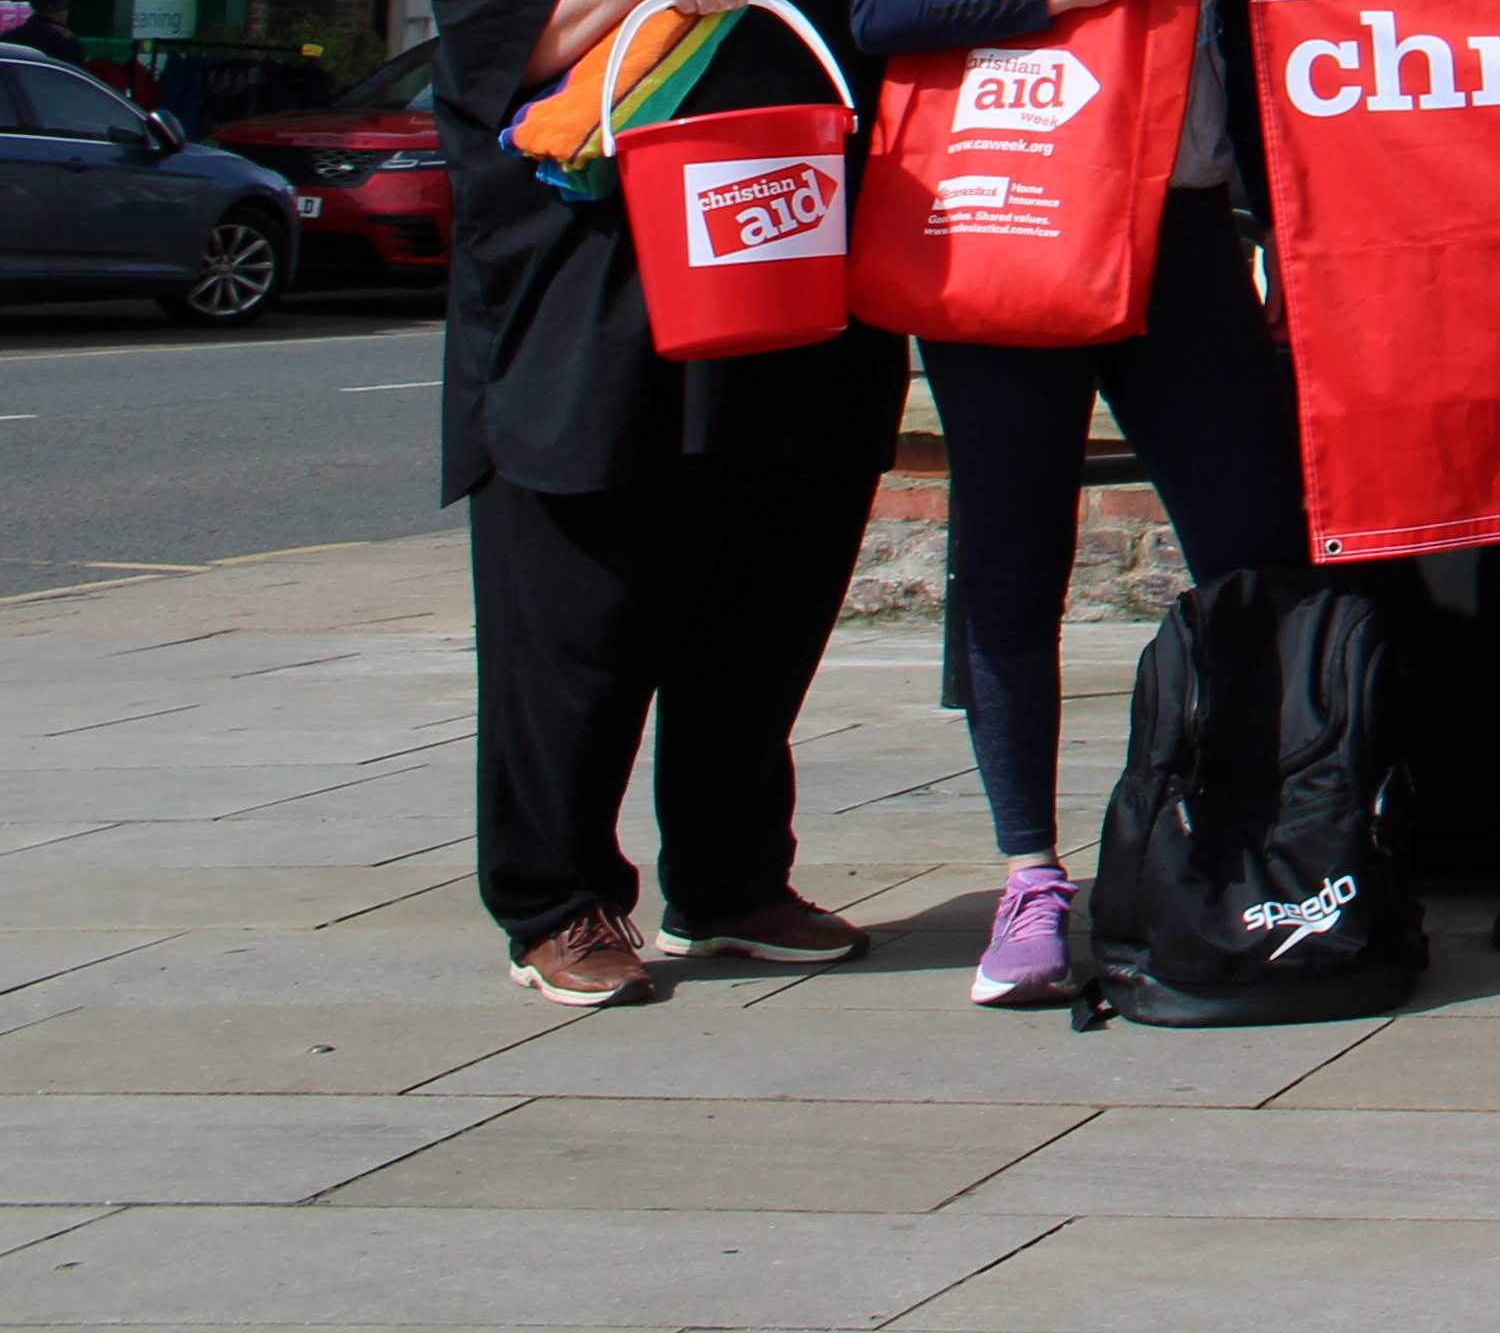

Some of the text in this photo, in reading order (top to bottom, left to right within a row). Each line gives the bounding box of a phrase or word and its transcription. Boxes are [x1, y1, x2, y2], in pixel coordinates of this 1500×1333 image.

[967, 54, 1042, 75] hristian
[975, 63, 1065, 111] aid
[1020, 111, 1059, 128] week
[699, 176, 797, 212] christian
[1011, 183, 1044, 194] Home
[735, 169, 830, 247] aid
[1242, 874, 1358, 932] speedo
